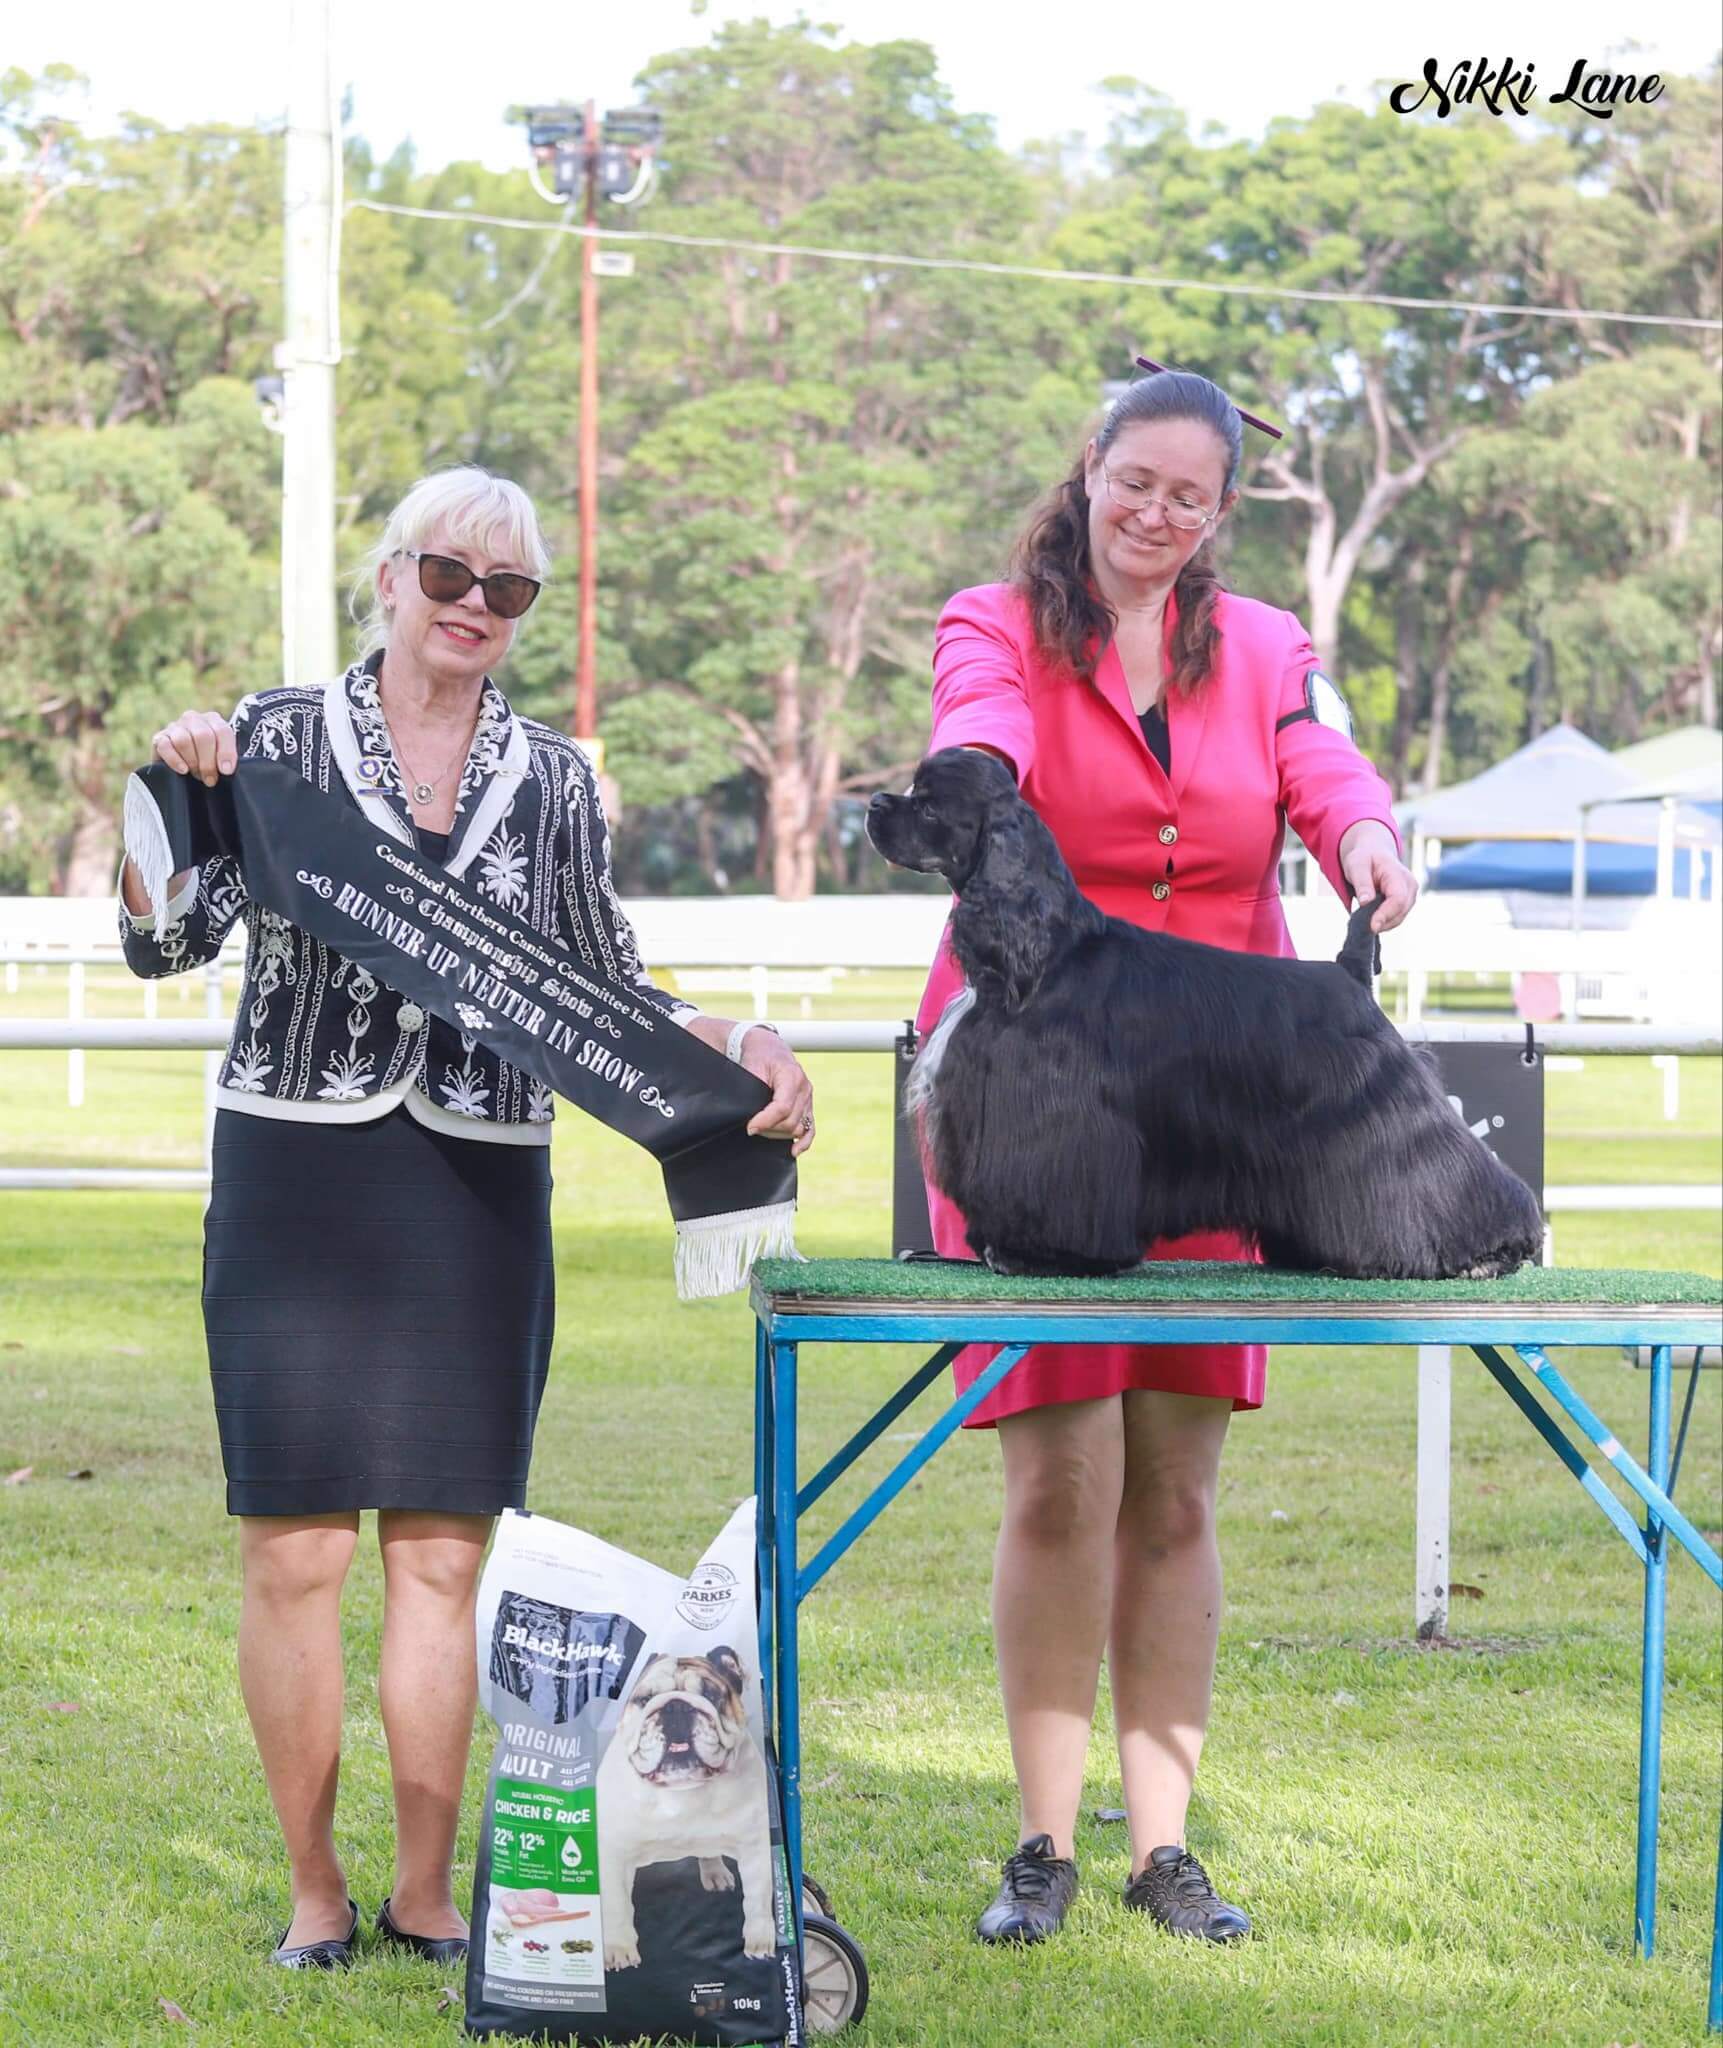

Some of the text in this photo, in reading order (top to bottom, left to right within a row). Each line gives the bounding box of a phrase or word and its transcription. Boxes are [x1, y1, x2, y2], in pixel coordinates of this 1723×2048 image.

[375, 844, 654, 1032] Combined Northern Canine Committee Inc.
[418, 898, 593, 1019] Championship Show
[333, 882, 645, 1093] RUNNER-UP NEUTER IN SHOW
[682, 1588, 732, 1602] PARKES
[502, 1624, 622, 1665] BlackHawk
[495, 1799, 591, 1824] CHICKEN & RICE
[519, 1832, 545, 1851] 12%
[732, 1998, 761, 2011] 10kg
